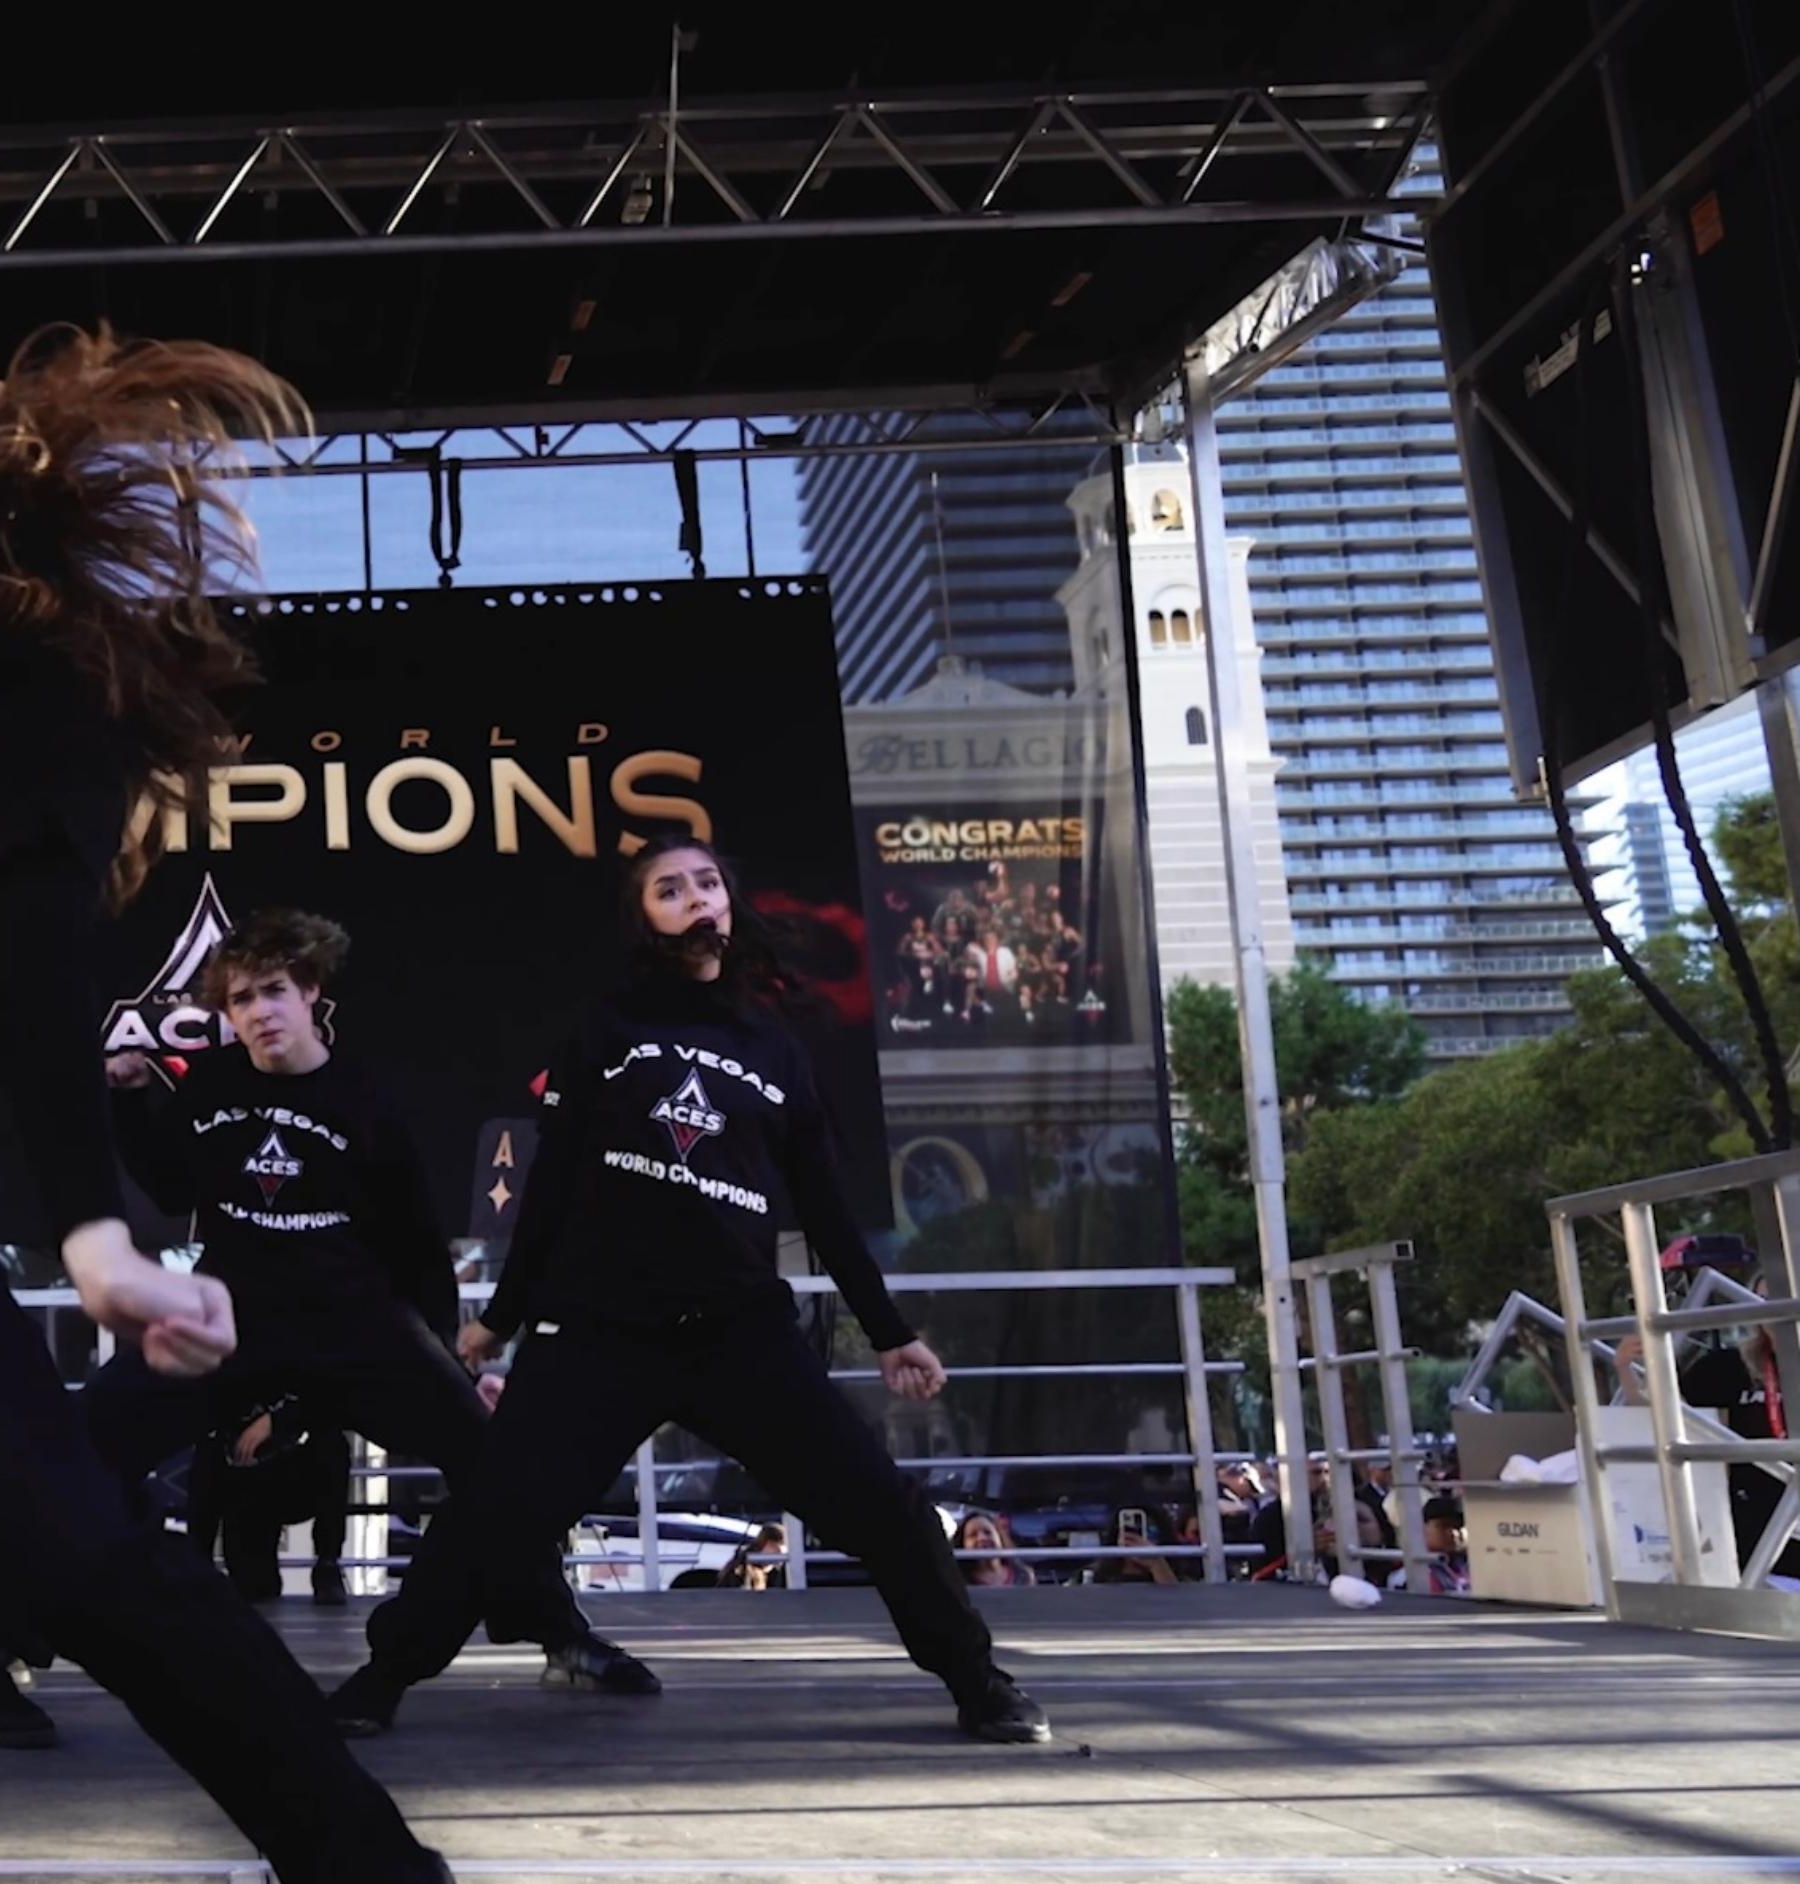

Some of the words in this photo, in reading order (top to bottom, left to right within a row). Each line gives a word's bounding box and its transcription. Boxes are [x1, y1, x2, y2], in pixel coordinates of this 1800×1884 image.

[213, 723, 608, 754] WORLD
[852, 733, 1106, 776] BELLAGIO
[120, 750, 713, 857] PIONS
[875, 817, 1086, 848] CONGRATS
[880, 847, 956, 864] WORLD
[960, 845, 1084, 861] CHAMPIONS
[103, 1006, 237, 1051] AC
[673, 1043, 786, 1106] VEGAS
[193, 1106, 249, 1135] LAS
[254, 1106, 349, 1151] VEGAS
[655, 1102, 722, 1132] ACES
[492, 1130, 514, 1168] A
[604, 1150, 667, 1180] WORLD
[244, 1157, 300, 1176] ACES
